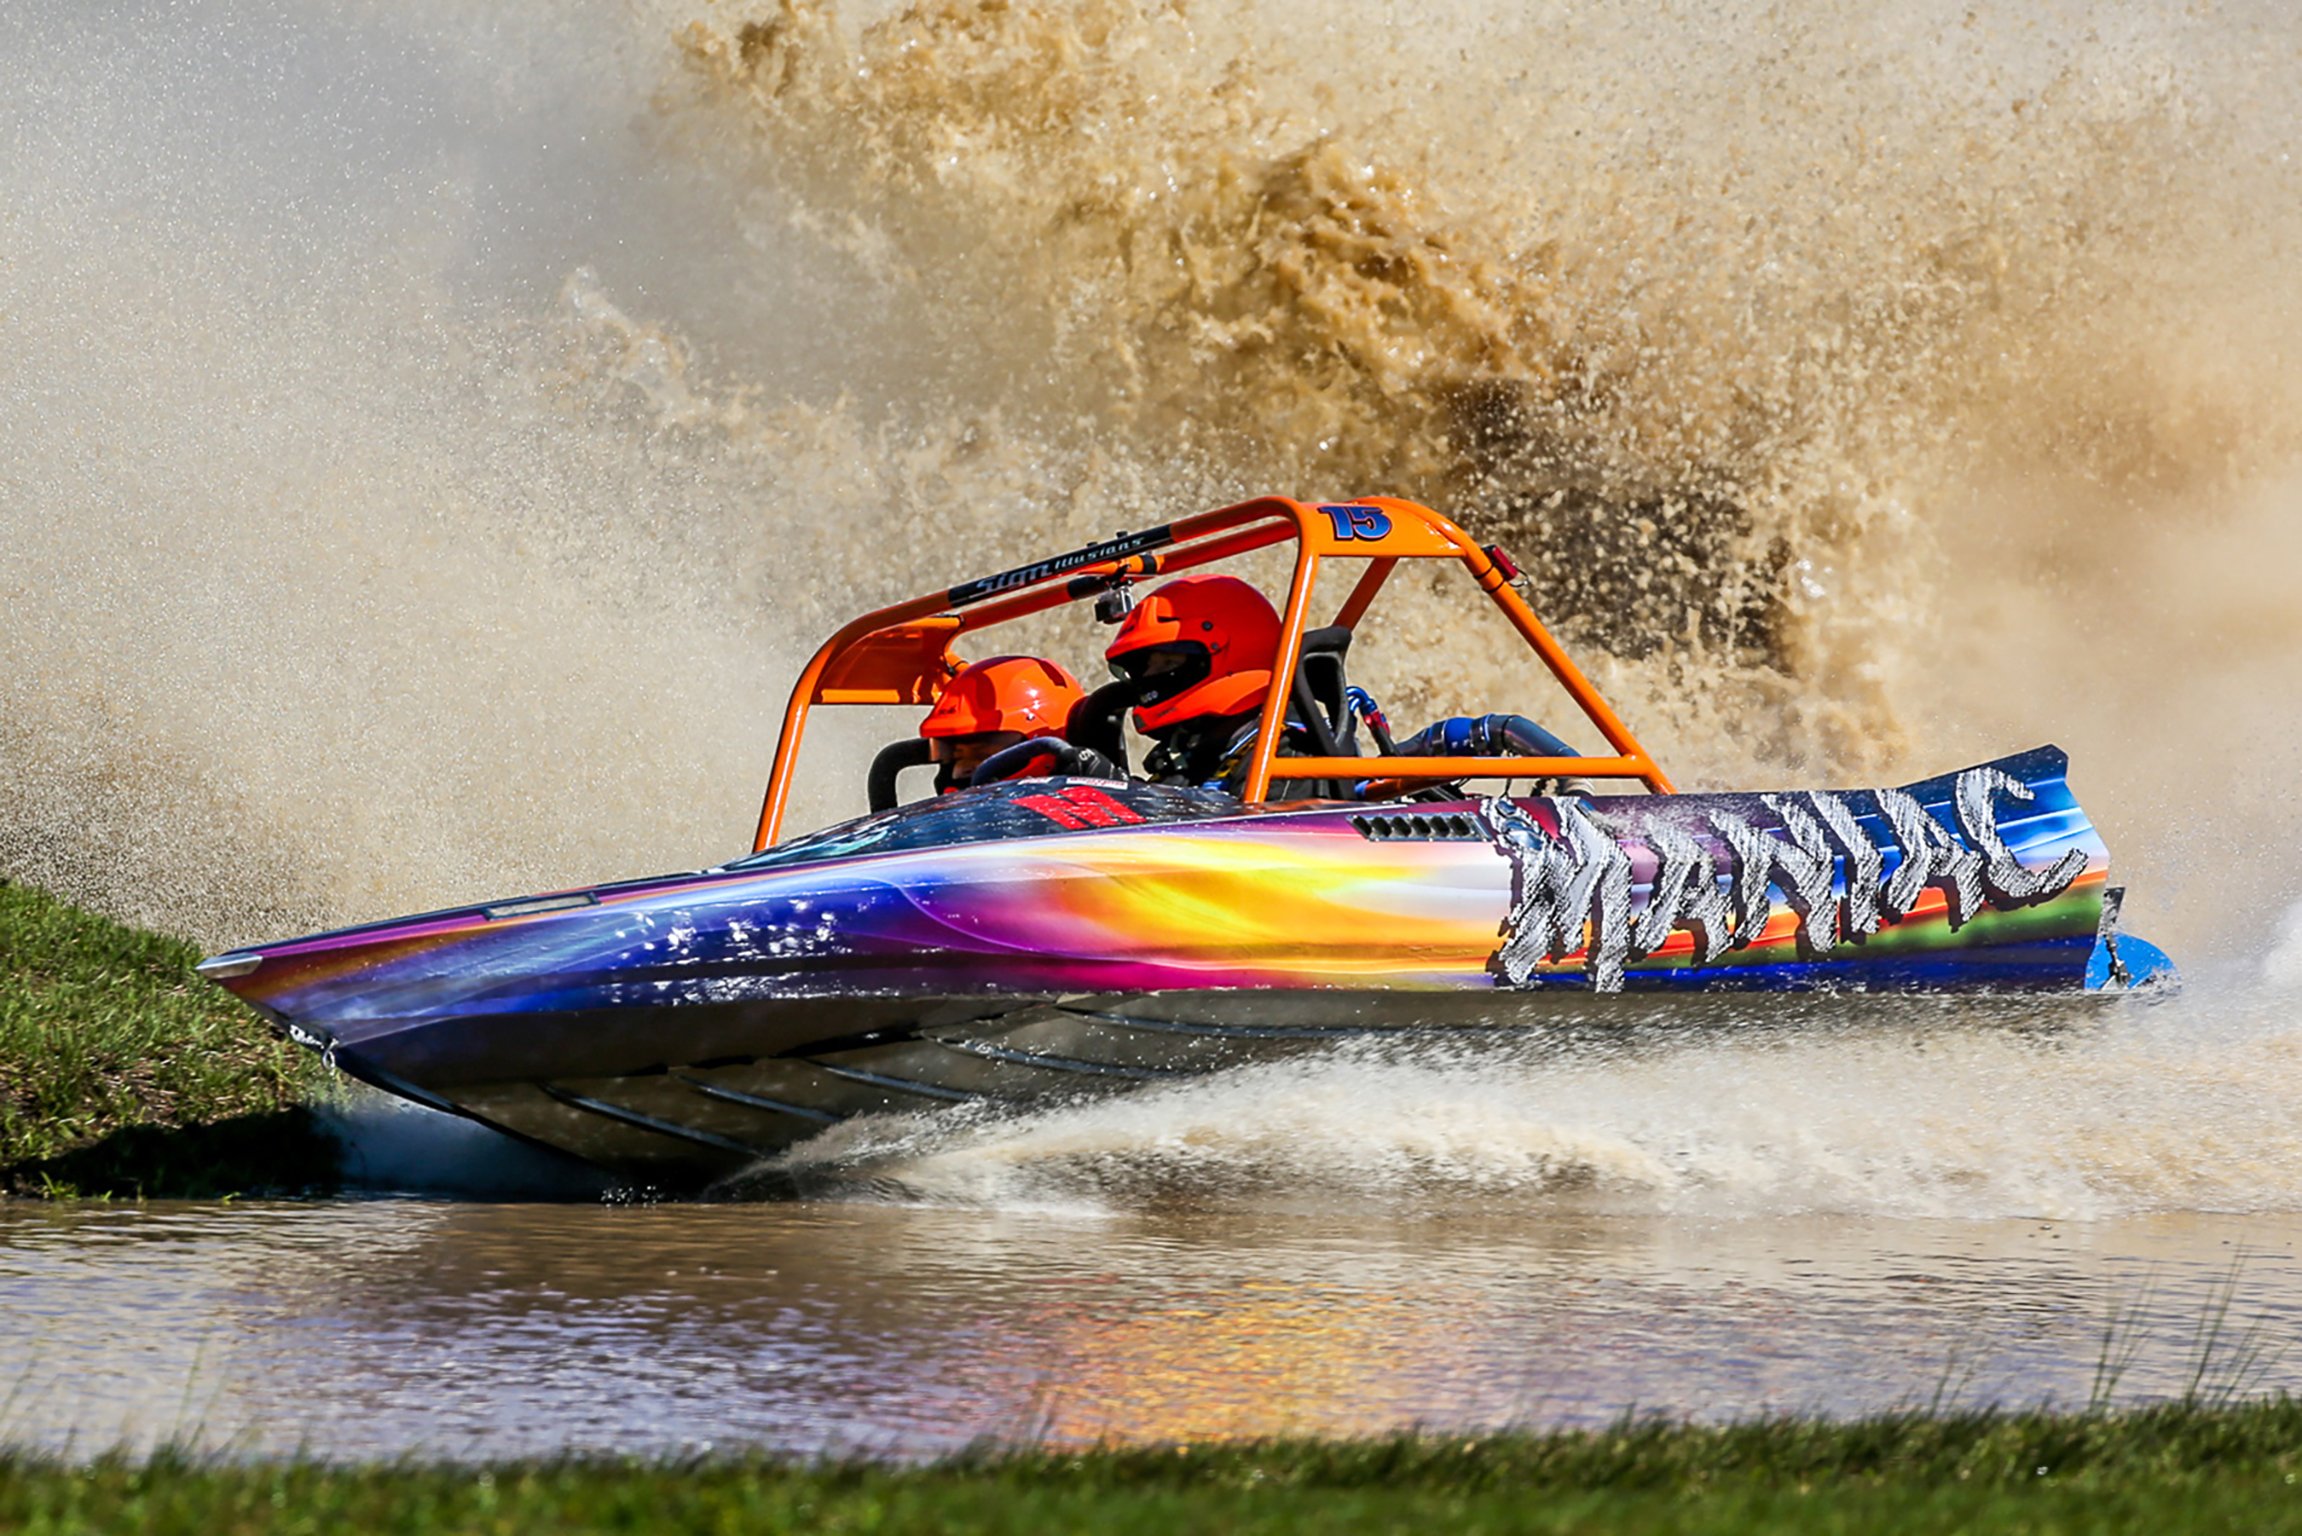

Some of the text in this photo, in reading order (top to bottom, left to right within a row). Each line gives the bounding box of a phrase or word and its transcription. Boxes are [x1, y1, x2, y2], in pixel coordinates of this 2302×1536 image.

[1317, 506, 1393, 541] 15
[975, 563, 1051, 593] Sign
[1481, 766, 2089, 994] MANIAC
